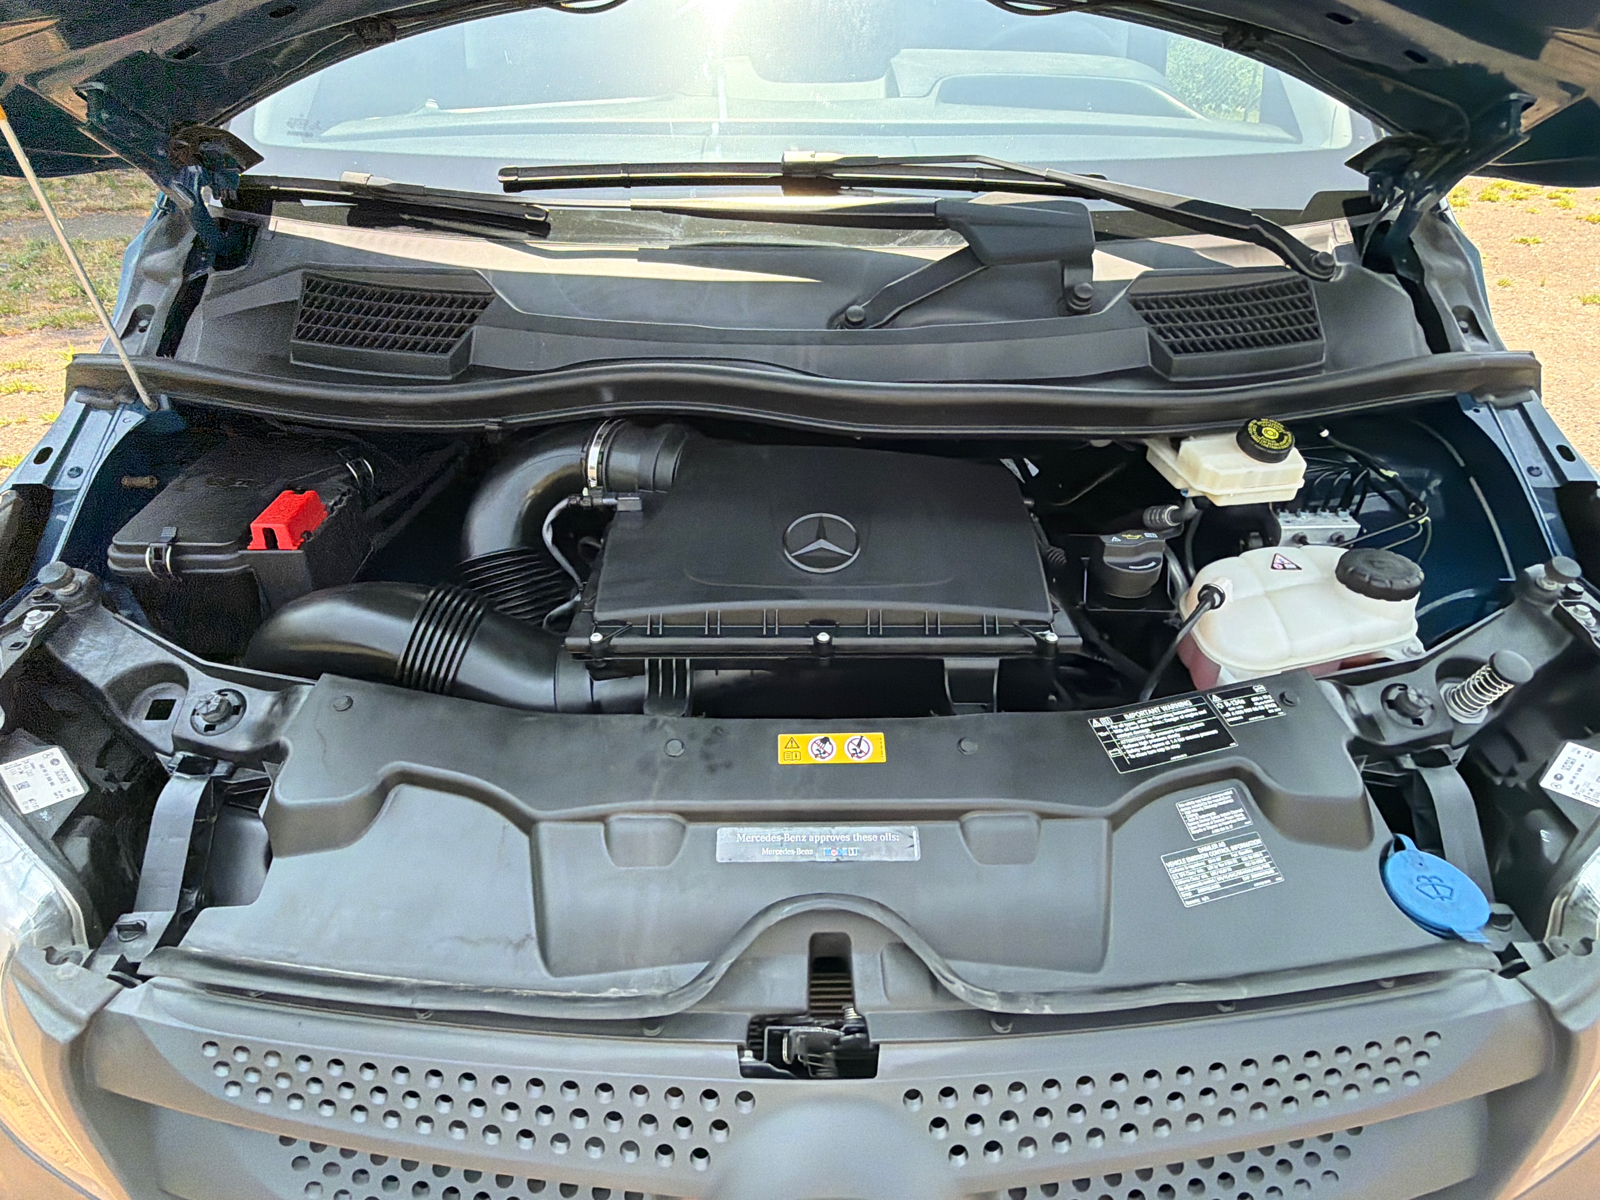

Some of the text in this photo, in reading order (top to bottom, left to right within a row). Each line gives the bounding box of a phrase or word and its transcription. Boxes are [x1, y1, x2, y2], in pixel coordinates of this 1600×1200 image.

[1123, 706, 1161, 720] IMPORTANT
[1161, 700, 1193, 712] WARNING
[736, 833, 900, 844] Mercedes-Benz approves these oils:
[762, 847, 813, 856] Mercedes-Benz
[1197, 841, 1226, 853] DAIMLER AG
[1165, 857, 1186, 868] VEHICLE
[1186, 852, 1209, 862] EMISSION
[1209, 847, 1231, 857] CONTROL
[1230, 839, 1262, 851] INFORMATION
